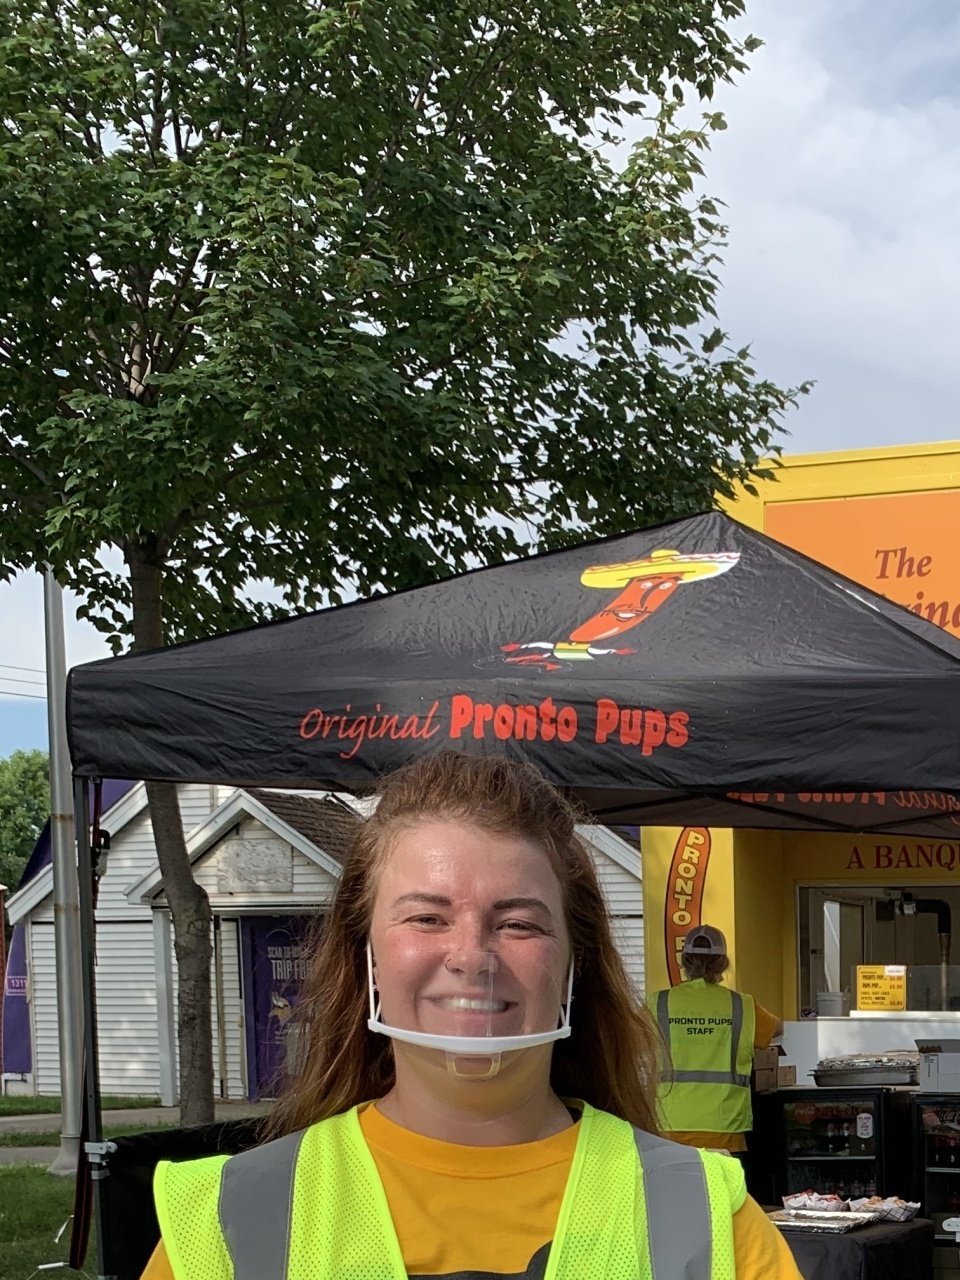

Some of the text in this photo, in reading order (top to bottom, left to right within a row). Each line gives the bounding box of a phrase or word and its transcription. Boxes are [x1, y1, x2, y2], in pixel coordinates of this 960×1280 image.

[875, 547, 932, 580] The
[300, 693, 690, 760] Original Pronto Pups
[846, 846, 865, 870] A
[672, 831, 705, 926] PRONTO
[271, 960, 292, 980] TRIP
[669, 1017, 733, 1026] PRONTO PUPS
[686, 1027, 715, 1035] STAFF
